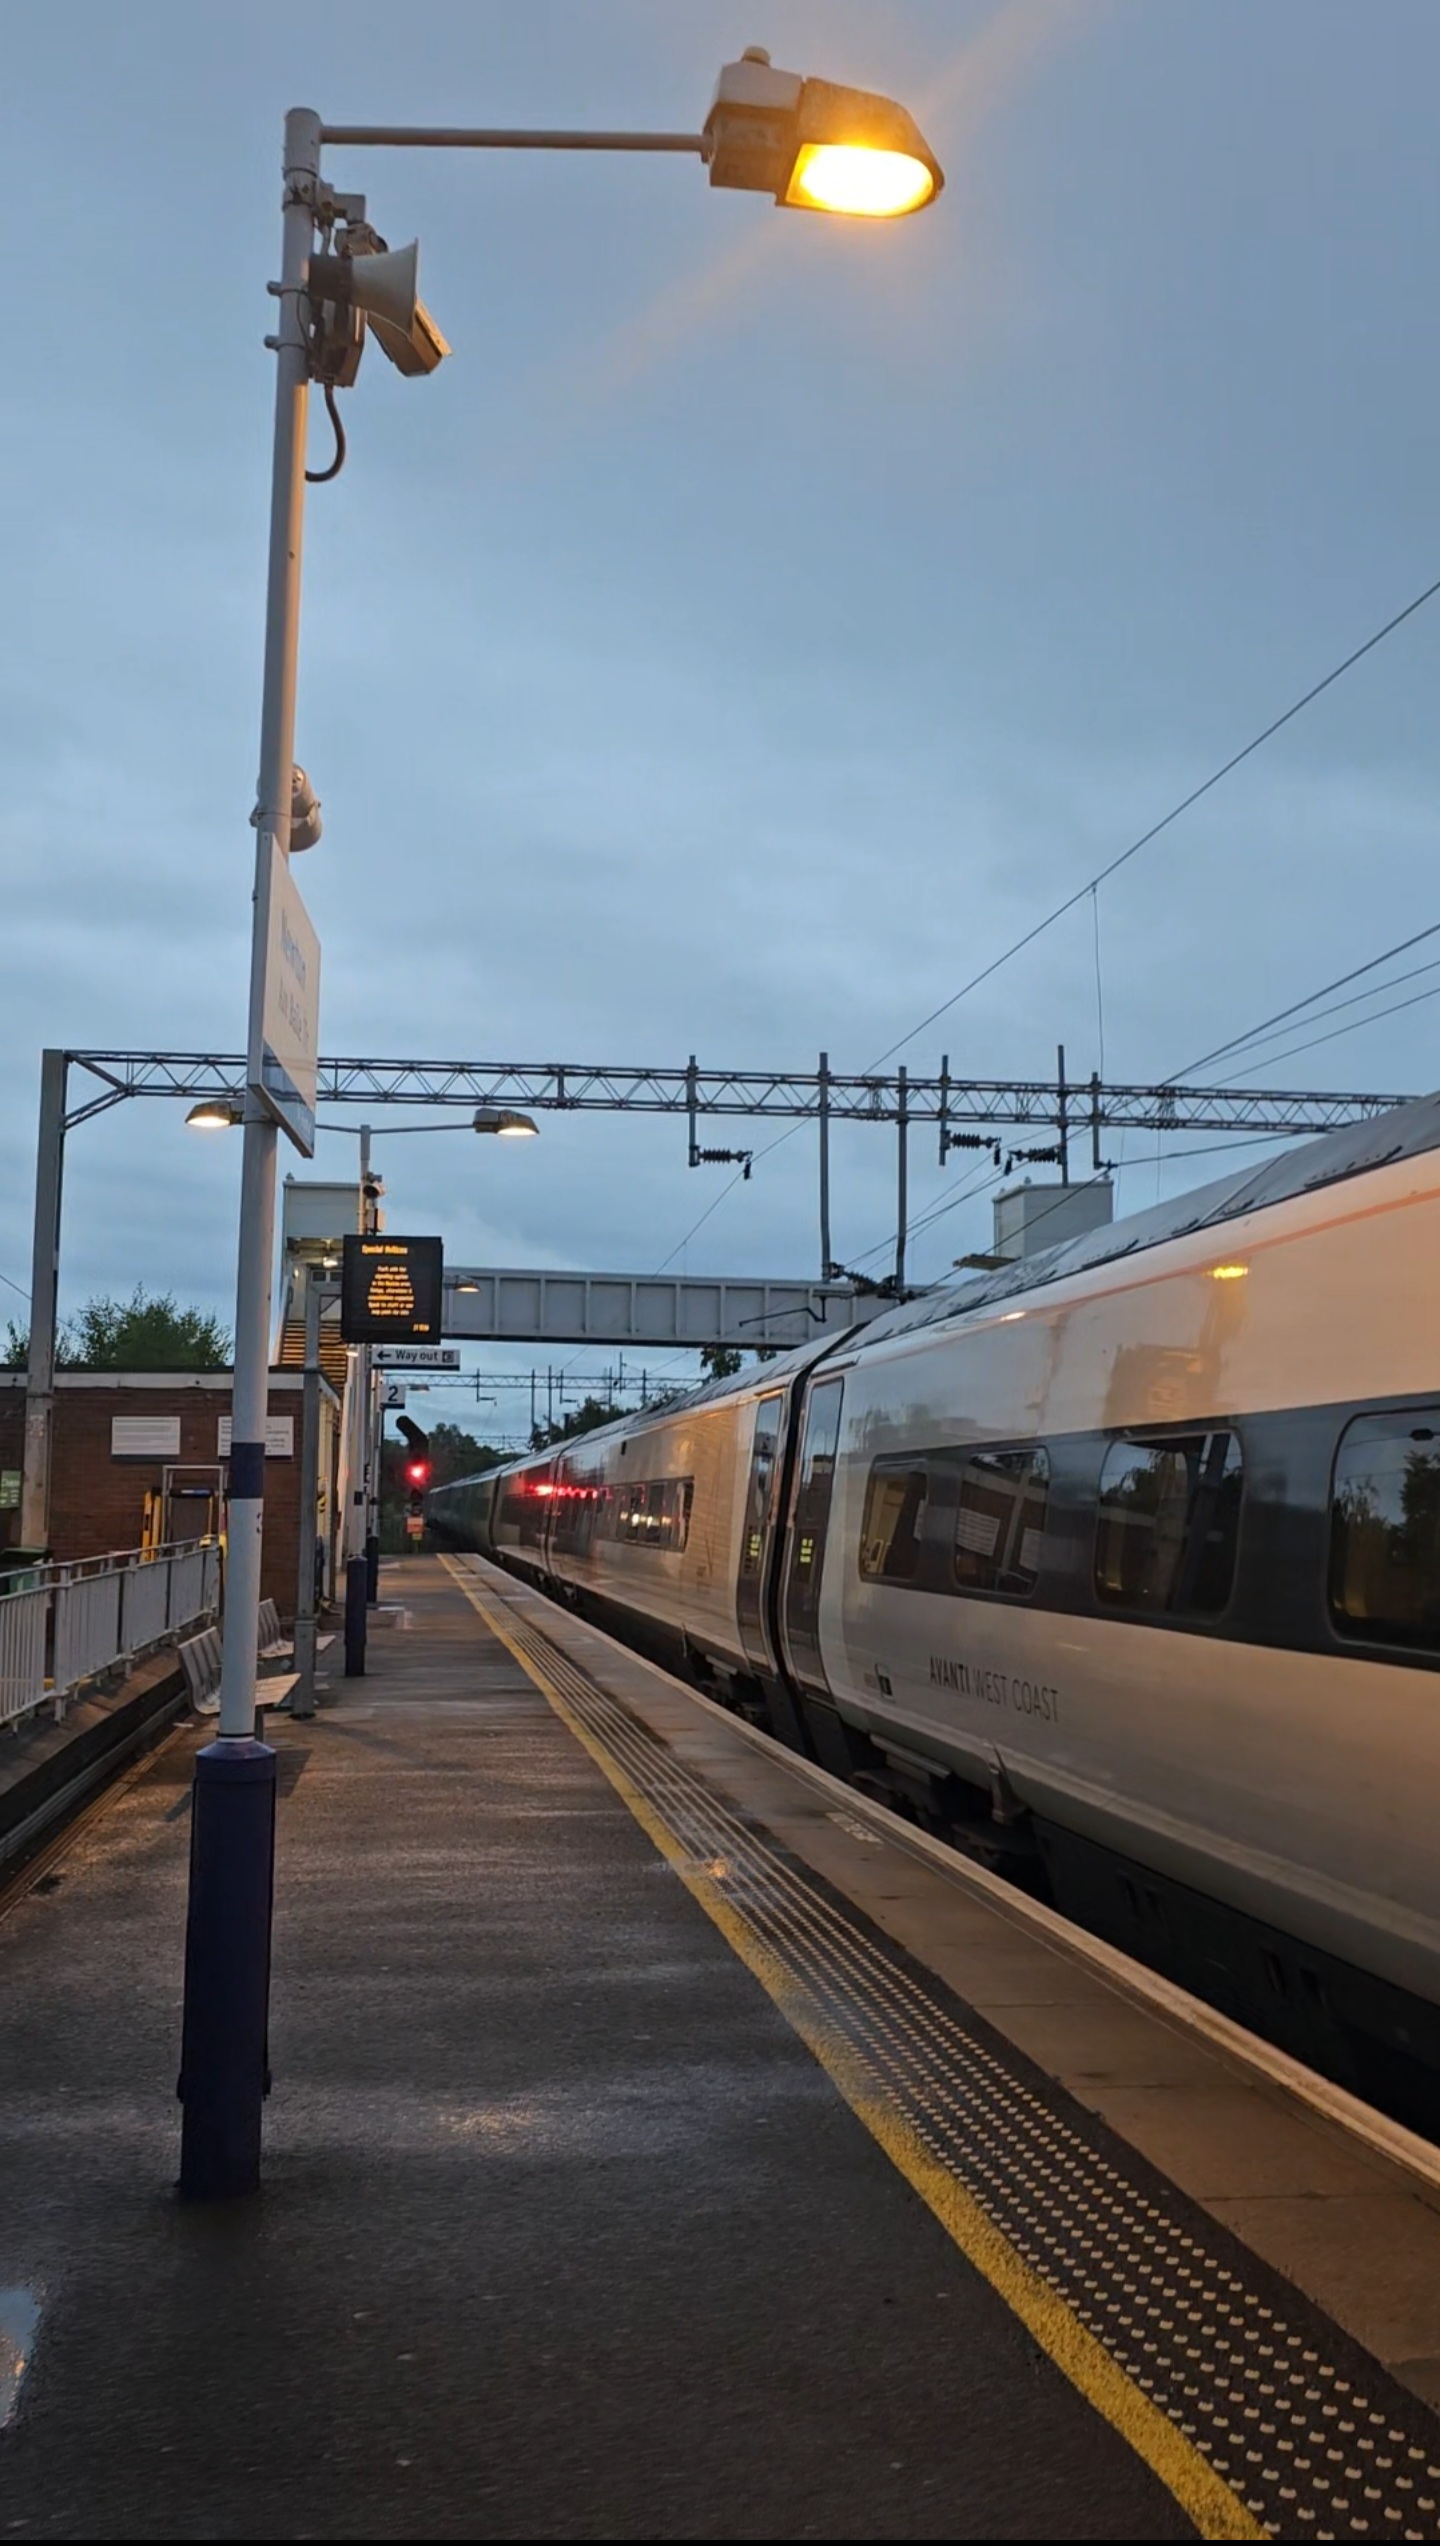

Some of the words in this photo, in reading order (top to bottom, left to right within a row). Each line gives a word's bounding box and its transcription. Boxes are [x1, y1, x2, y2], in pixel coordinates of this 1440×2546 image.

[395, 1350, 418, 1362] Way
[420, 1351, 438, 1361] out
[388, 1386, 398, 1401] 2
[930, 1655, 970, 1694] AVANTI
[972, 1669, 1008, 1706] WEST
[1011, 1678, 1059, 1723] COAST
